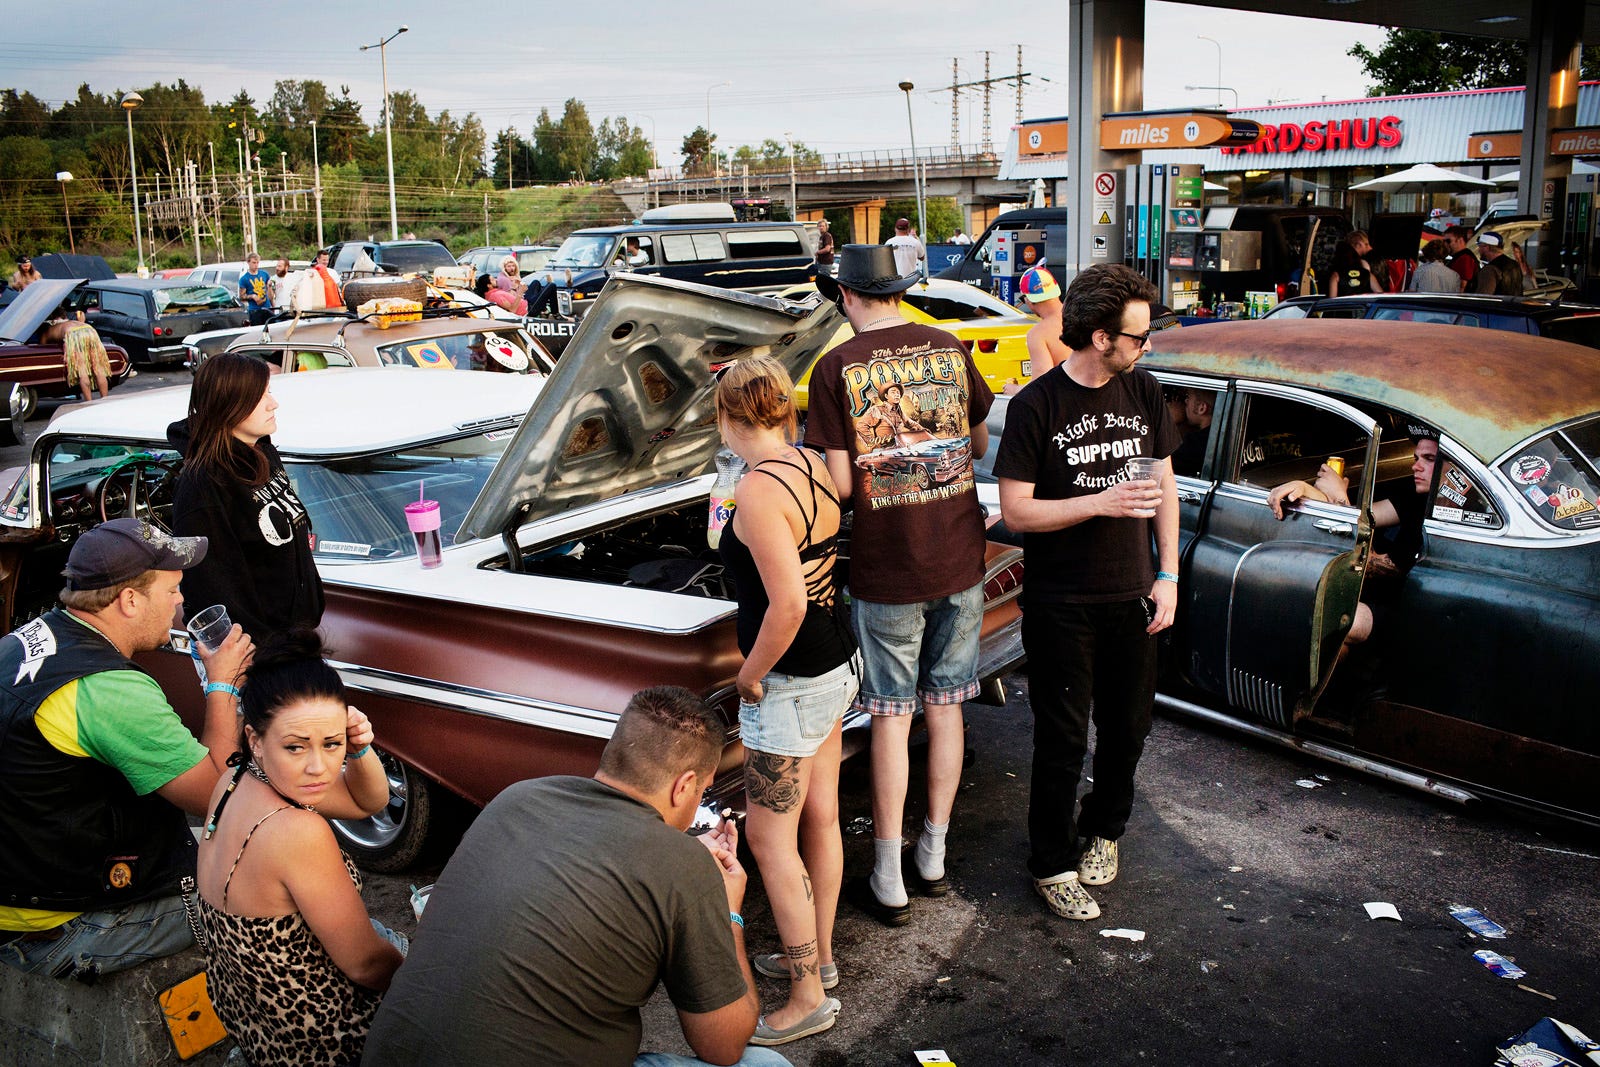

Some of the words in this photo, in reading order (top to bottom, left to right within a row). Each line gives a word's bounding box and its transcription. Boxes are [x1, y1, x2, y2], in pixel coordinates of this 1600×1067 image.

[1031, 134, 1040, 145] 12
[1120, 123, 1170, 145] miles
[1187, 126, 1196, 137] 11
[1220, 115, 1402, 155] RDSHUS
[872, 348, 893, 359] 37th
[895, 341, 932, 355] Annual
[842, 349, 969, 417] POWER
[1052, 413, 1099, 450] Right
[1103, 412, 1149, 436] Backs
[1066, 437, 1142, 466] SUPPORT
[871, 496, 892, 510] KING
[893, 495, 902, 505] OF
[902, 491, 919, 503] THE
[919, 489, 939, 503] WILD
[938, 483, 963, 499] WEST
